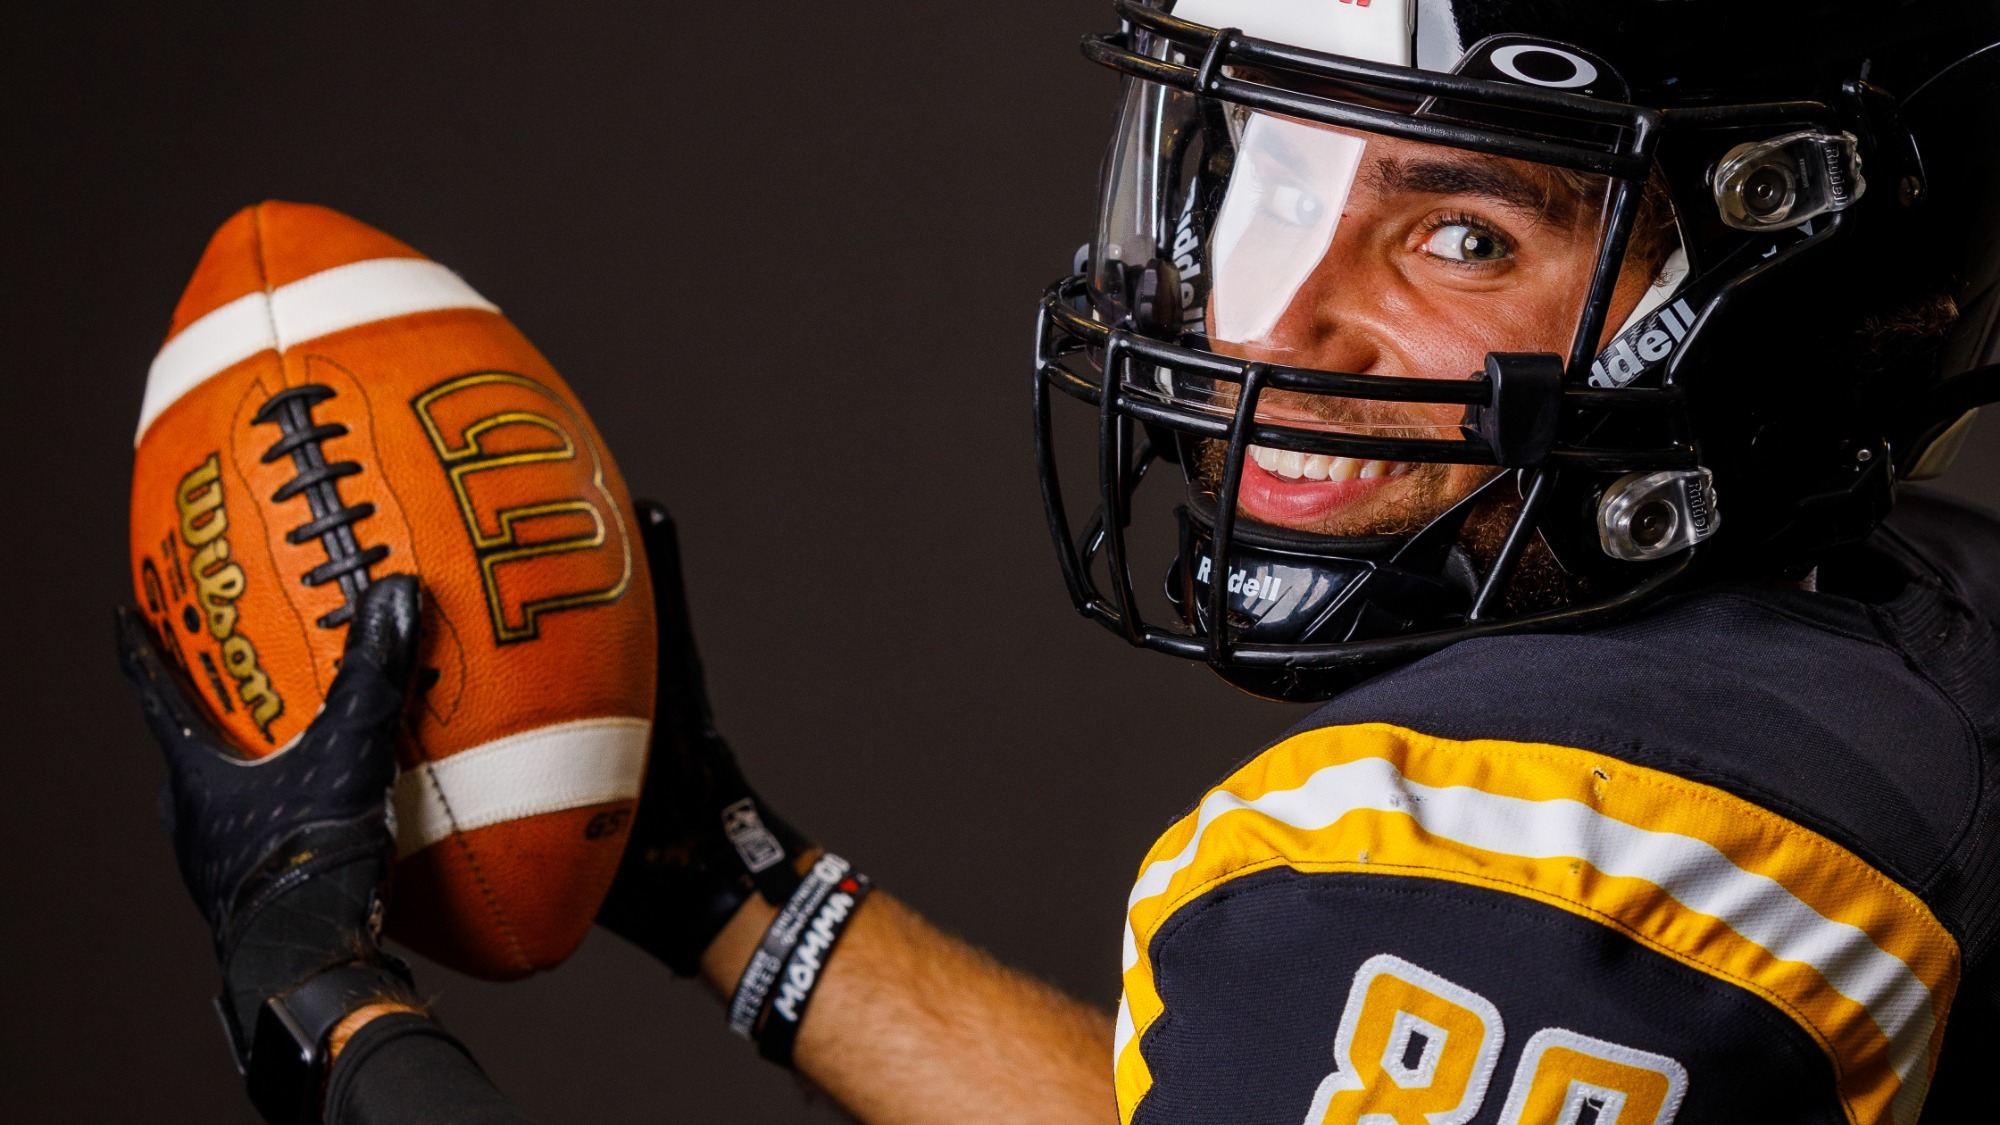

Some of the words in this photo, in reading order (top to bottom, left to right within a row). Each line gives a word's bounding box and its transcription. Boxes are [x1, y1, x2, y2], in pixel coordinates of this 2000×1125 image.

[1824, 146, 1849, 206] Riddell
[1588, 298, 1697, 388] ddell
[176, 450, 286, 746] Wilson
[1196, 555, 1282, 602] Rdell
[774, 892, 854, 1022] MOMMA
